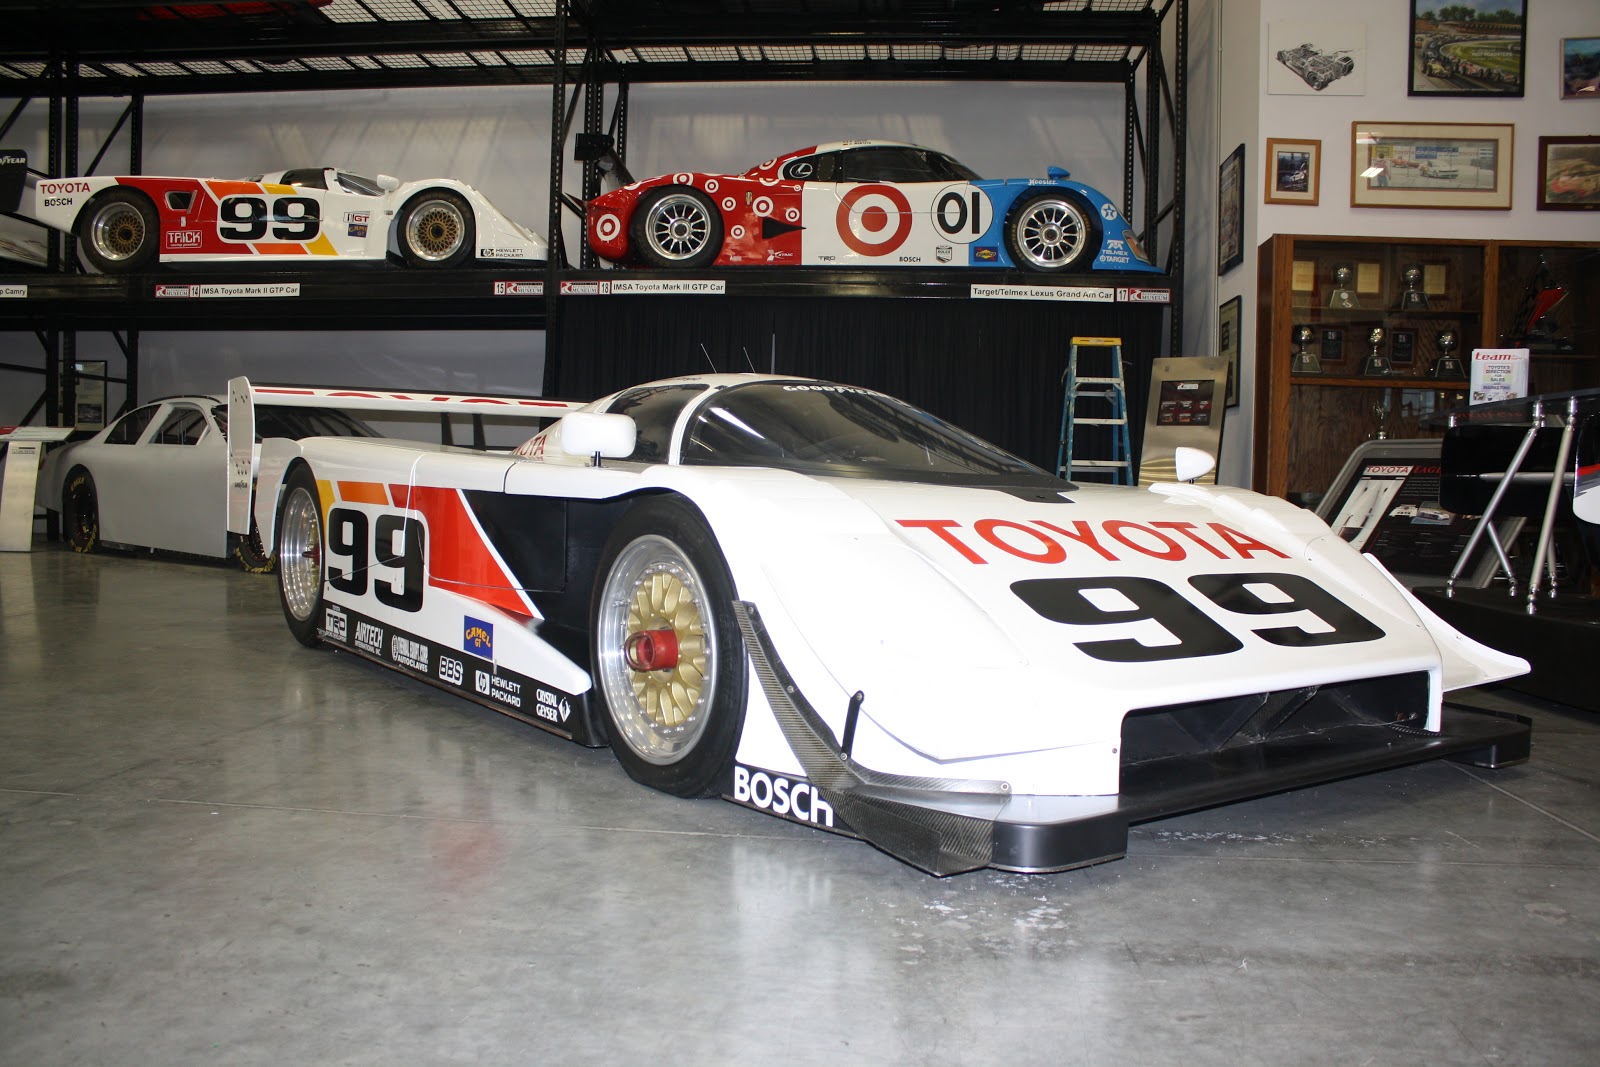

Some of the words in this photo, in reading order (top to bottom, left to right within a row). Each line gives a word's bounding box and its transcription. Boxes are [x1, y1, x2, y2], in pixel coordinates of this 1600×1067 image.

[40, 182, 91, 195] TOYOTA
[44, 198, 73, 207] BOSCH
[220, 197, 320, 240] 99
[936, 191, 981, 235] 01
[168, 231, 201, 243] TRICK
[1106, 255, 1130, 264] TARGET
[5, 288, 26, 296] Camry
[192, 286, 199, 297] 14
[201, 287, 219, 295] IMSA
[221, 287, 243, 296] Toyota
[269, 286, 284, 294] GTP
[285, 286, 298, 294] Car
[497, 282, 505, 294] 15
[601, 282, 609, 294] 18
[613, 283, 633, 291] IMSA
[635, 283, 661, 291] Toyota
[662, 283, 681, 291] Mark
[691, 283, 708, 291] GTP
[710, 283, 724, 291] Car
[973, 287, 1028, 298] Target/Telmex
[1030, 289, 1054, 297] Lexus
[1056, 290, 1081, 298] Grand
[1098, 291, 1113, 299] Car
[1118, 290, 1127, 300] 17
[1475, 352, 1512, 361] team
[1366, 466, 1409, 474] TOYOTA
[1414, 466, 1442, 474] EAGL
[895, 518, 1292, 565] TOYOTA
[327, 507, 426, 613] 99
[1009, 572, 1387, 663] 99
[354, 620, 384, 650] AIRTECH
[465, 626, 492, 648] CAMEL
[474, 637, 482, 648] GT
[396, 653, 429, 673] AUTOCLAVES
[439, 656, 464, 685] BBS
[491, 675, 521, 695] HEWLETT
[491, 688, 521, 708] PACKARD
[536, 688, 558, 708] CRYSTAL
[536, 703, 558, 723] GEYSER
[734, 765, 834, 828] BOSCH
